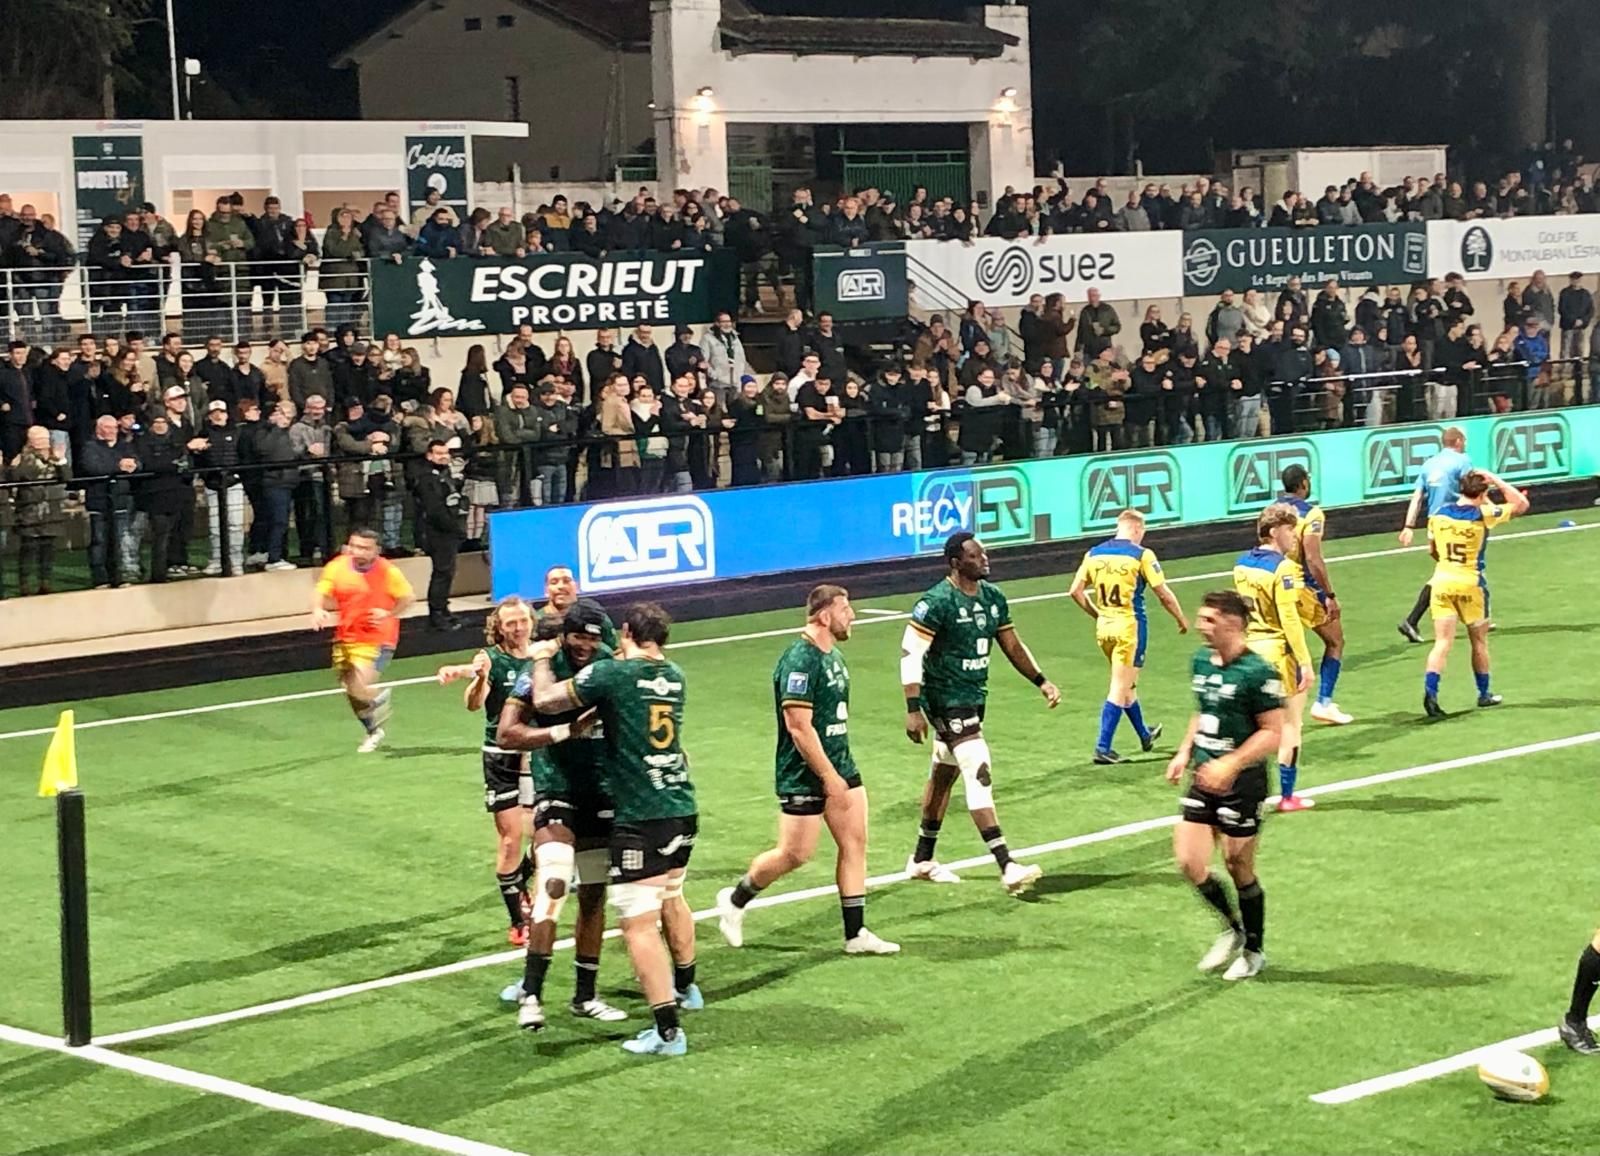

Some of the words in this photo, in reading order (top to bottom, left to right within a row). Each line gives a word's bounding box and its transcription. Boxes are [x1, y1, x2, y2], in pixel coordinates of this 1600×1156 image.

[1226, 233, 1395, 268] GUEULETON
[470, 259, 704, 302] ESCRIEUT
[1039, 253, 1115, 283] suez
[512, 295, 670, 325] PROPRETÉ
[892, 495, 973, 537] RECY
[1446, 543, 1467, 564] 15
[1099, 583, 1123, 607] 14
[649, 704, 675, 750] 5
